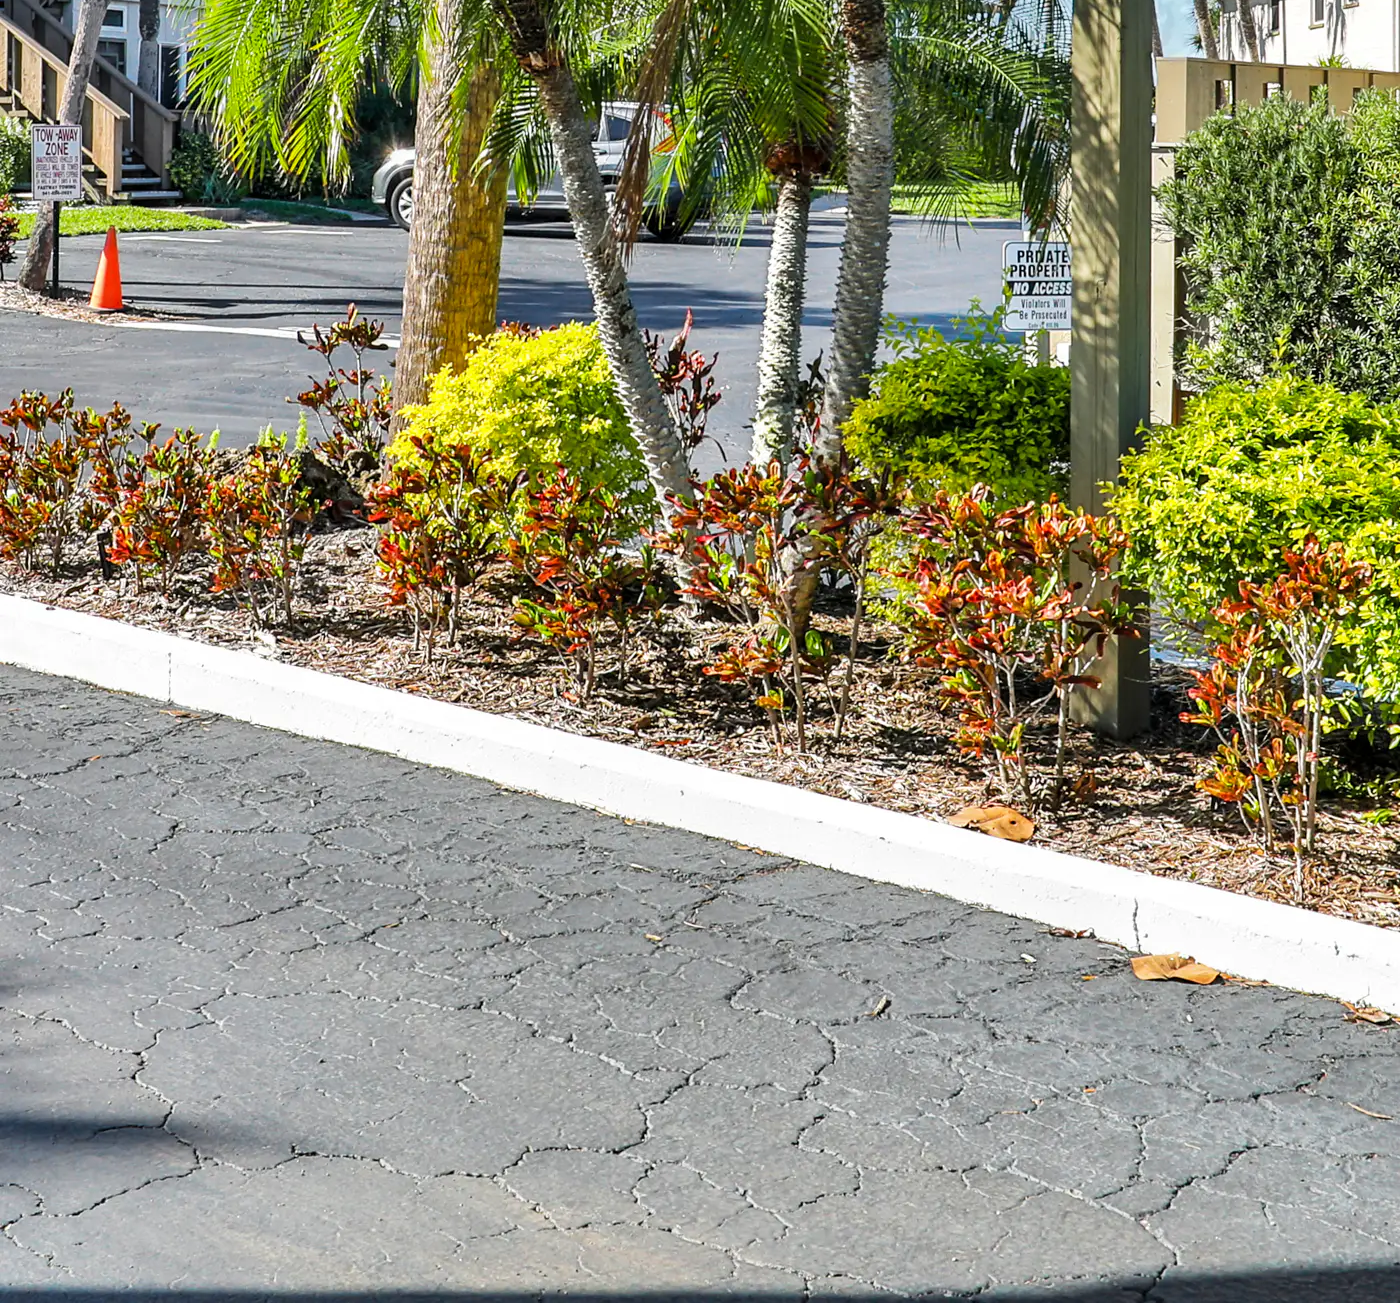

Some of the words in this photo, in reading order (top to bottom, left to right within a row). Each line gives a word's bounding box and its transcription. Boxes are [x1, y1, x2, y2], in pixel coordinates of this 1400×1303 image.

[45, 143, 68, 155] ZONE
[1012, 282, 1029, 295] NO
[1032, 282, 1072, 295] ACCESS
[1021, 298, 1050, 308] Violators
[1053, 298, 1066, 308] Will
[1020, 310, 1028, 320] Be
[1031, 310, 1067, 320] Prosecuted
